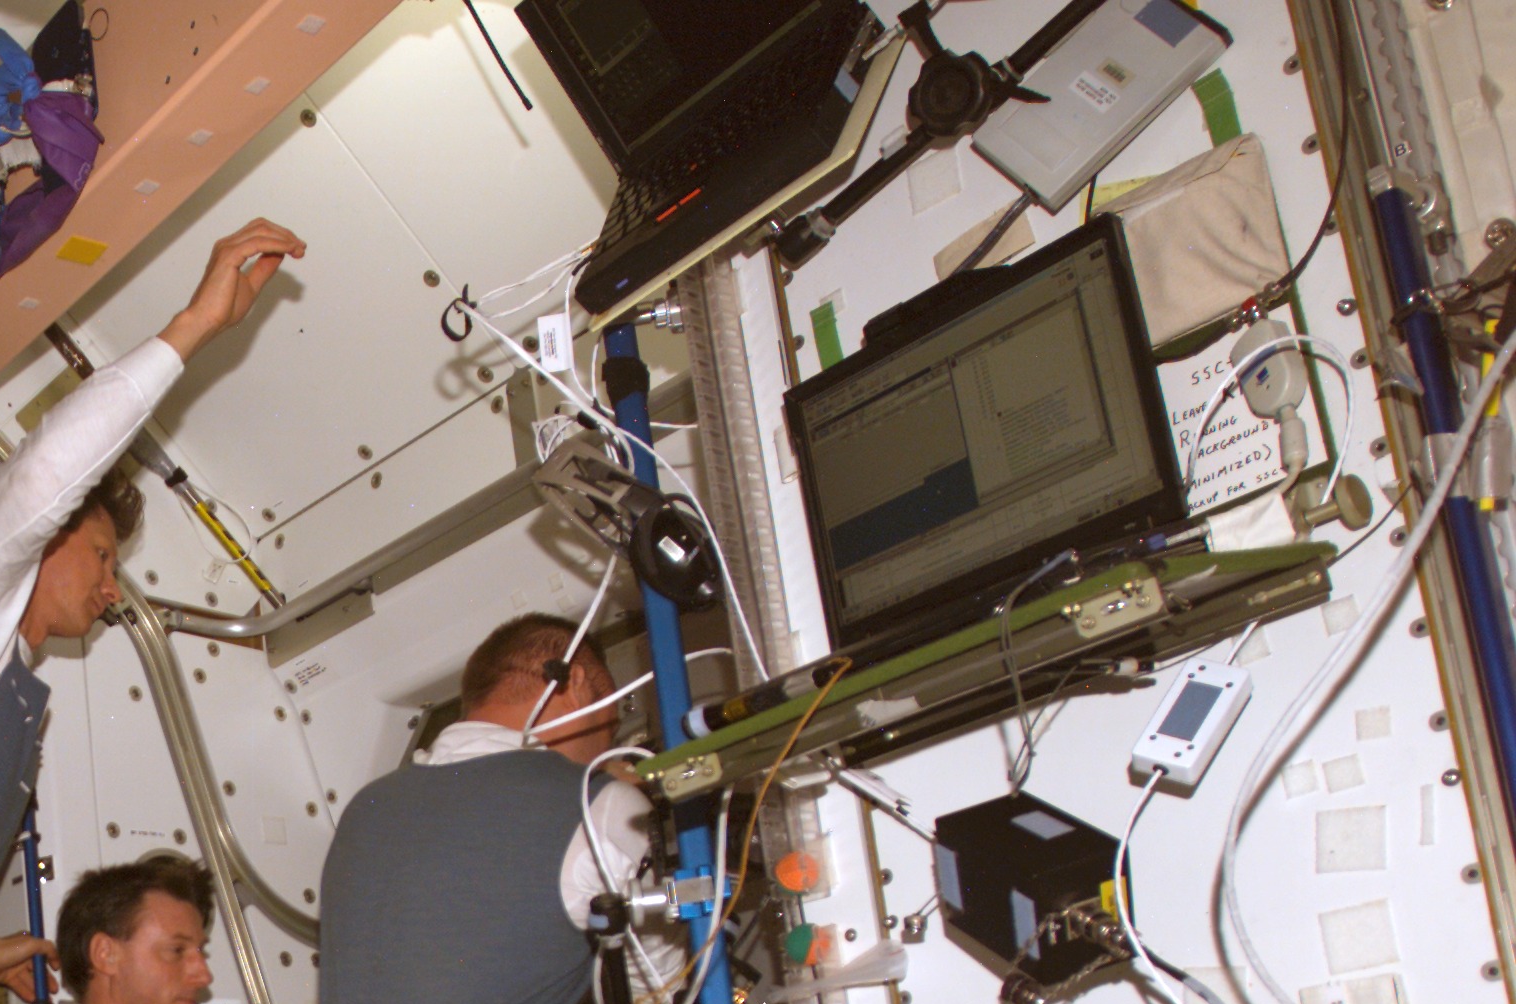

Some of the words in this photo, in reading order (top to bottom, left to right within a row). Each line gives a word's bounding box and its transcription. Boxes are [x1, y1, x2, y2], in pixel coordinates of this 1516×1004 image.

[1180, 415, 1238, 449] RNNING
[1195, 420, 1270, 460] ACKGROUND
[1187, 490, 1219, 512] ACKUP
[1226, 481, 1247, 496] FOR
